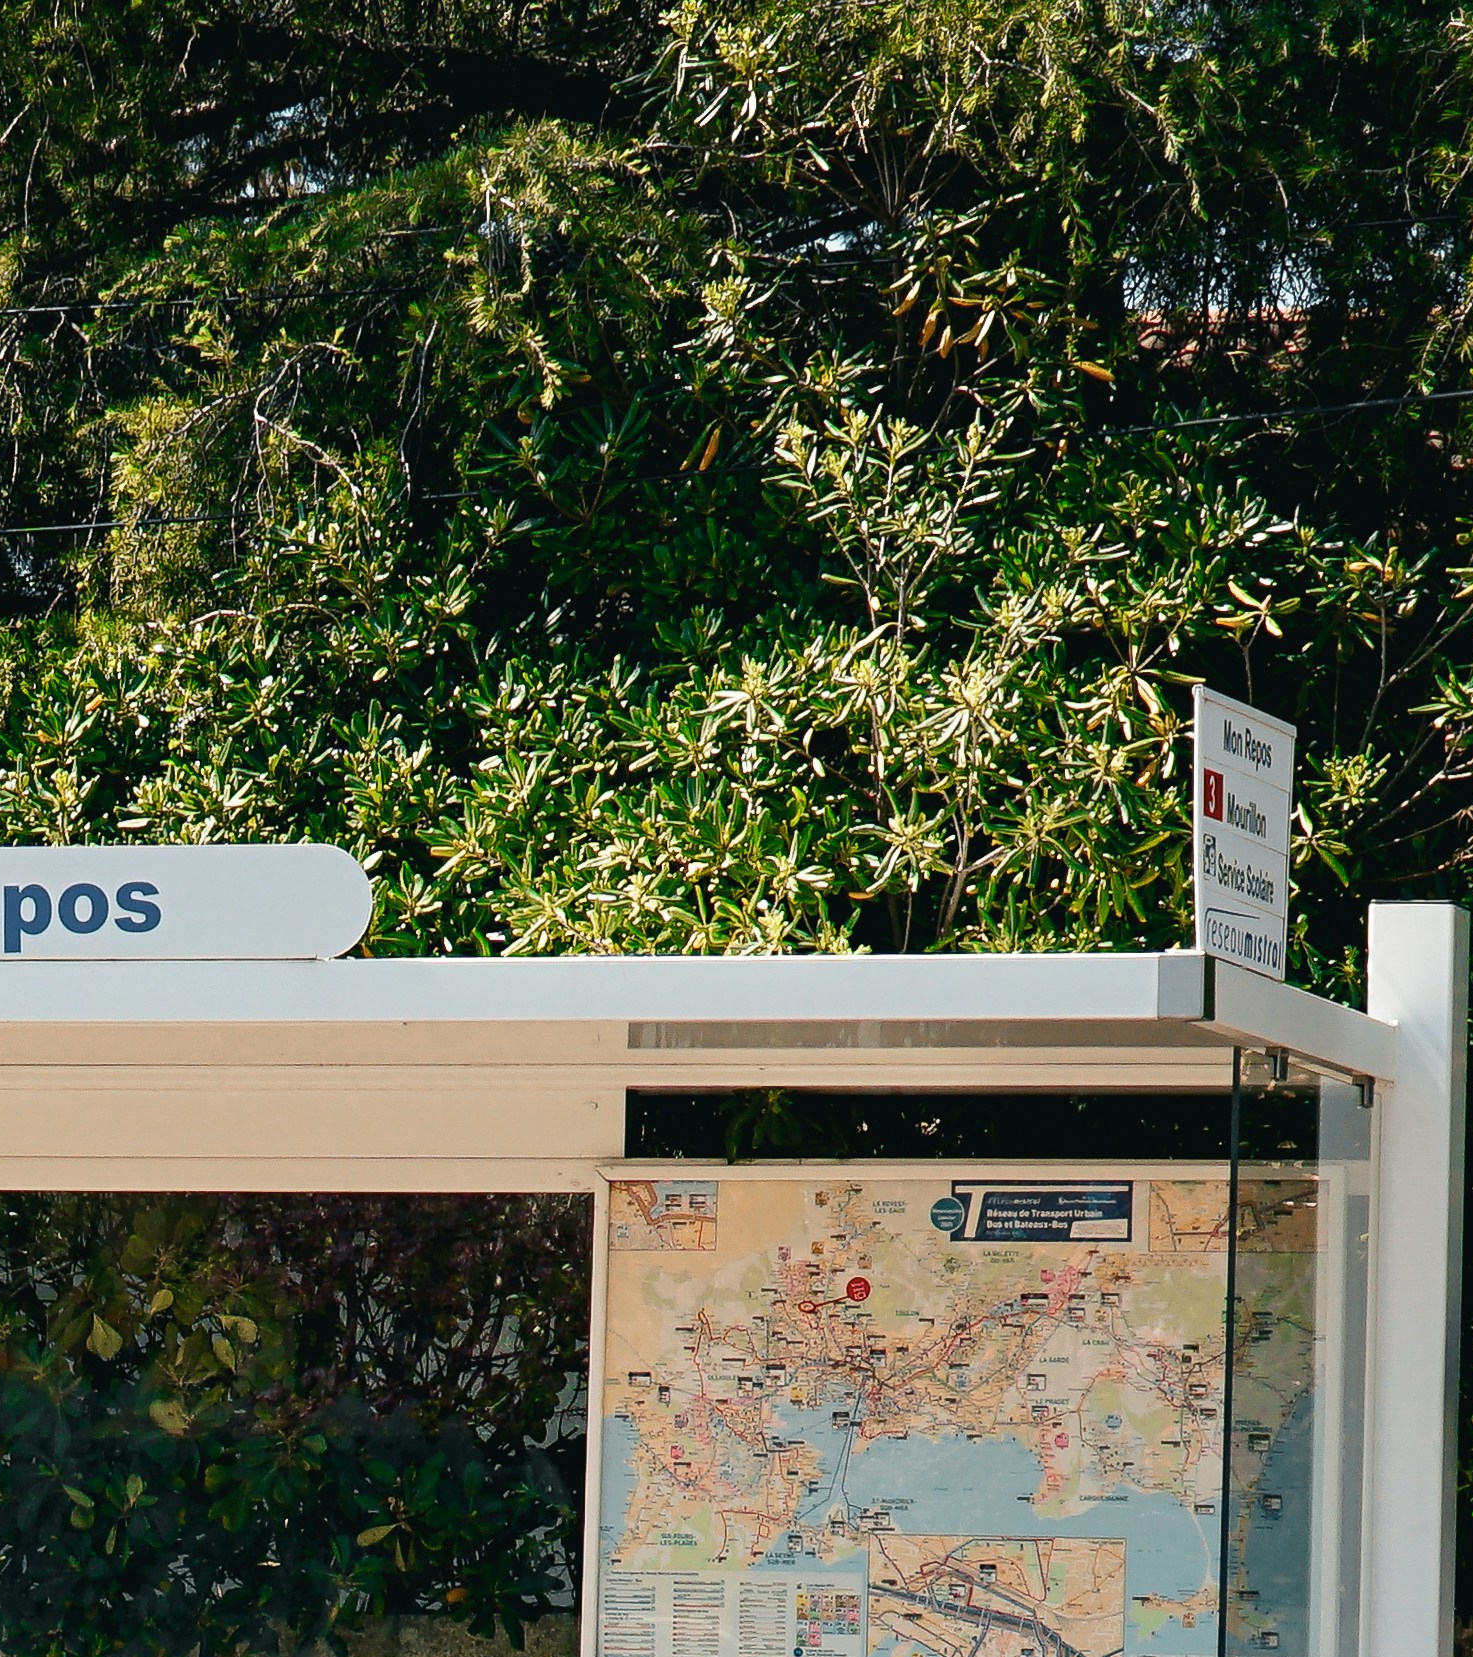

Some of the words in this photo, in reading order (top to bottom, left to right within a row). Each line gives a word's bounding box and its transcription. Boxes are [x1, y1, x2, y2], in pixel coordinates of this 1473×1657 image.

[1223, 719, 1243, 757] Mon
[1245, 727, 1272, 772] Repos
[1209, 775, 1216, 814] 3
[1226, 792, 1266, 838] Mourillon
[1218, 852, 1245, 893] Service
[1246, 864, 1274, 904] Scolaire
[986, 1208, 1017, 1218] Réseau
[1019, 1209, 1029, 1217] de
[1031, 1209, 1073, 1218] Transport
[1074, 1209, 1103, 1218] Urbain
[986, 1220, 1002, 1229] Bus
[1004, 1220, 1013, 1229] et
